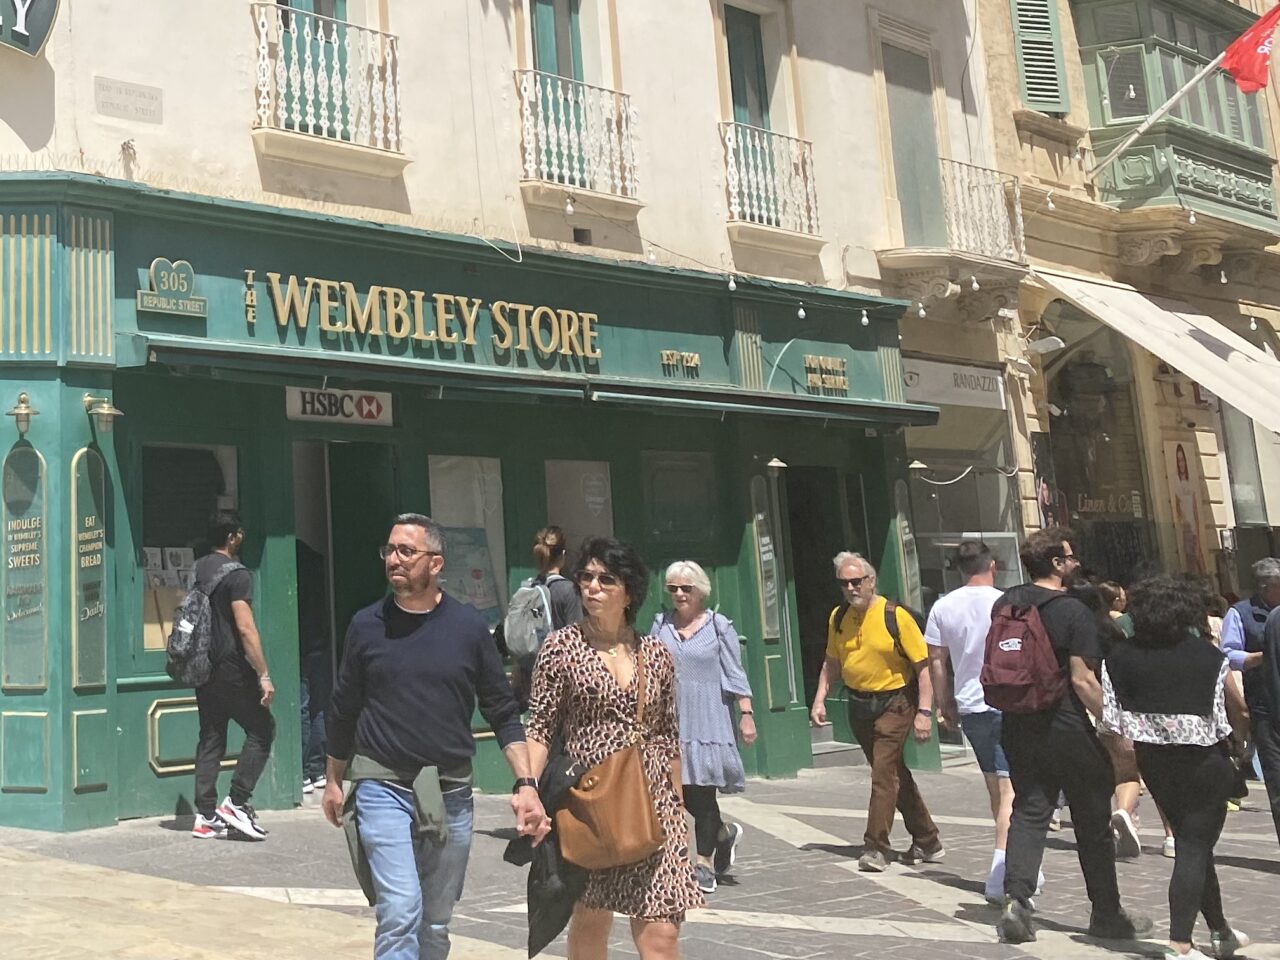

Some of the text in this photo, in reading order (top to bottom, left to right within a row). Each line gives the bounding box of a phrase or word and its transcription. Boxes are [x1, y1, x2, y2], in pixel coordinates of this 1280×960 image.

[160, 271, 188, 292] 305
[143, 295, 204, 313] REPUBLIC STREET
[244, 269, 602, 358] THE WEMBLEY STORE
[952, 372, 998, 392] RANDAZZO
[300, 390, 354, 418] HSBC
[8, 516, 41, 531] INDULGE
[85, 515, 96, 528] EAT
[10, 541, 39, 553] SUPREME
[8, 553, 40, 568] SWEETS
[81, 553, 101, 568] BREAD
[80, 601, 104, 621] Daily
